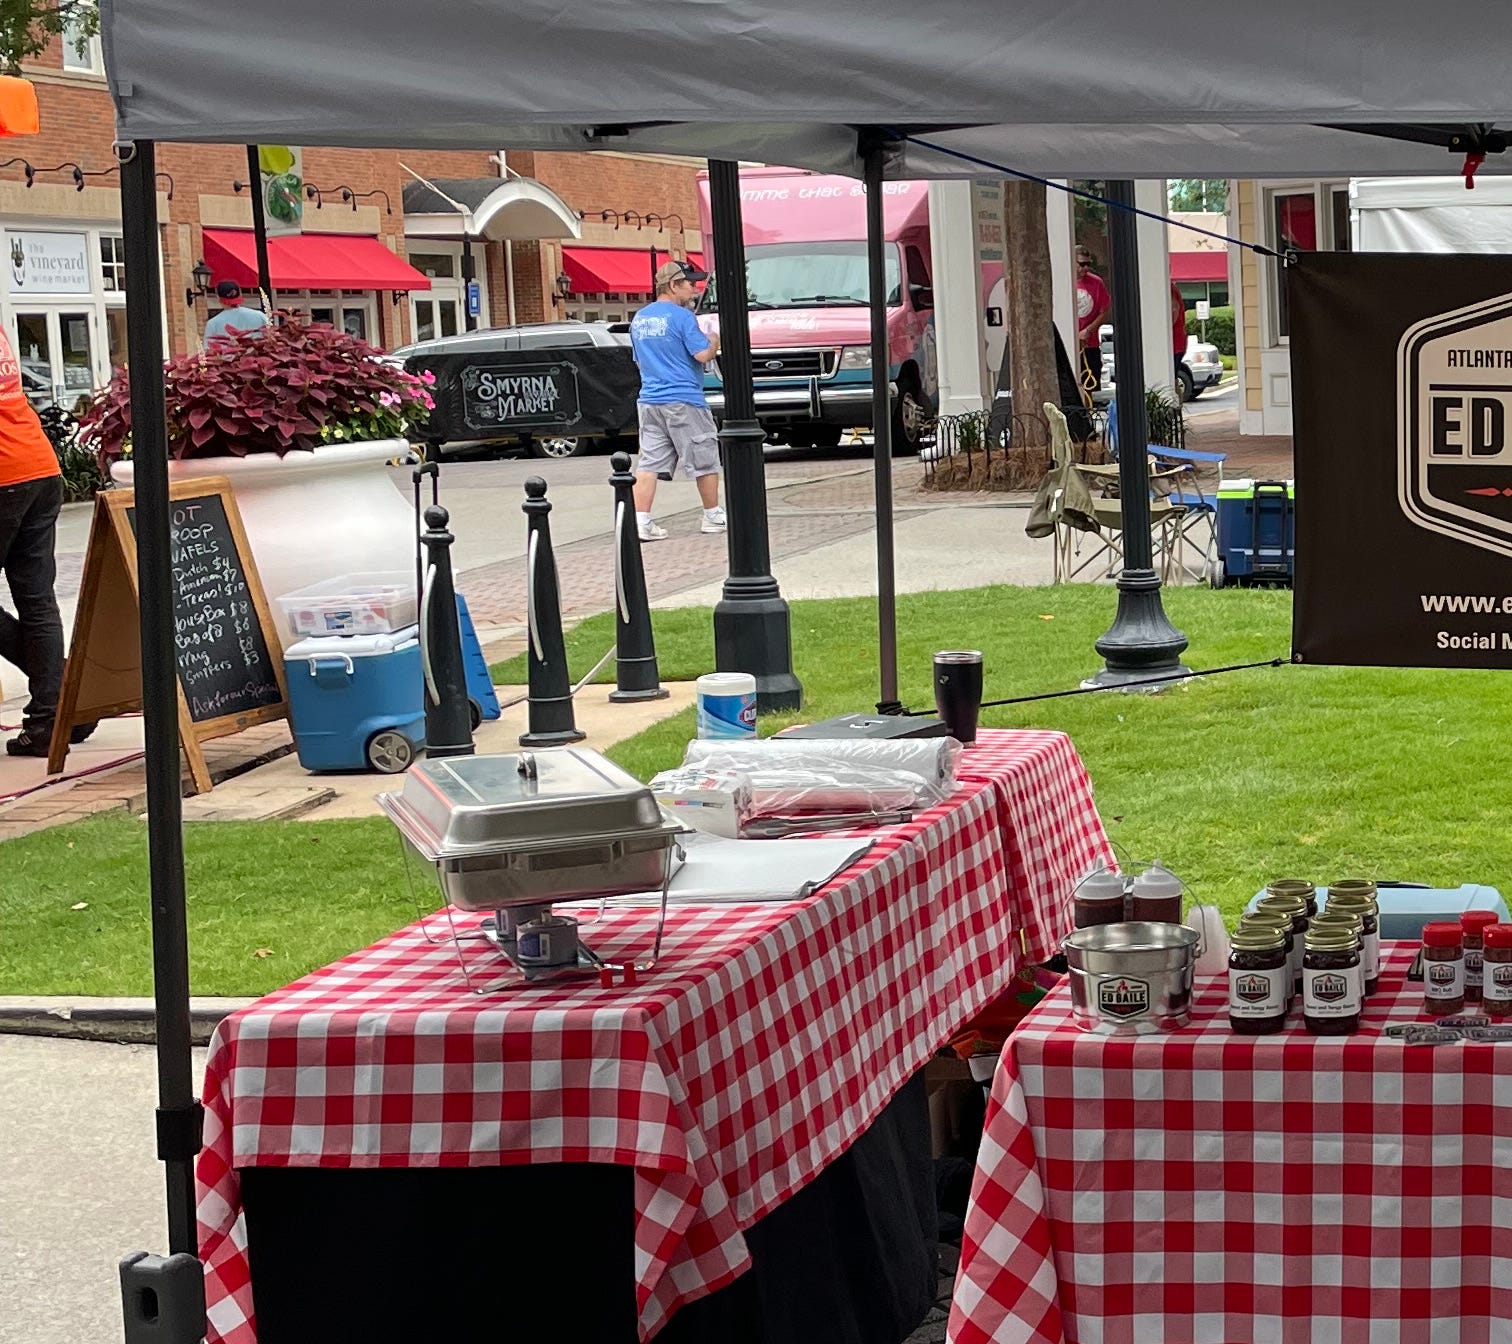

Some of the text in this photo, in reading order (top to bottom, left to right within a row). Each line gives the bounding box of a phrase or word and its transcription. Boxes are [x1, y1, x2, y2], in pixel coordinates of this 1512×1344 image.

[30, 252, 84, 273] vineyard
[497, 395, 555, 422] MARKET
[1429, 395, 1504, 458] ED
[173, 505, 202, 525] OT
[171, 523, 214, 545] ROOP
[1436, 631, 1497, 651] Social
